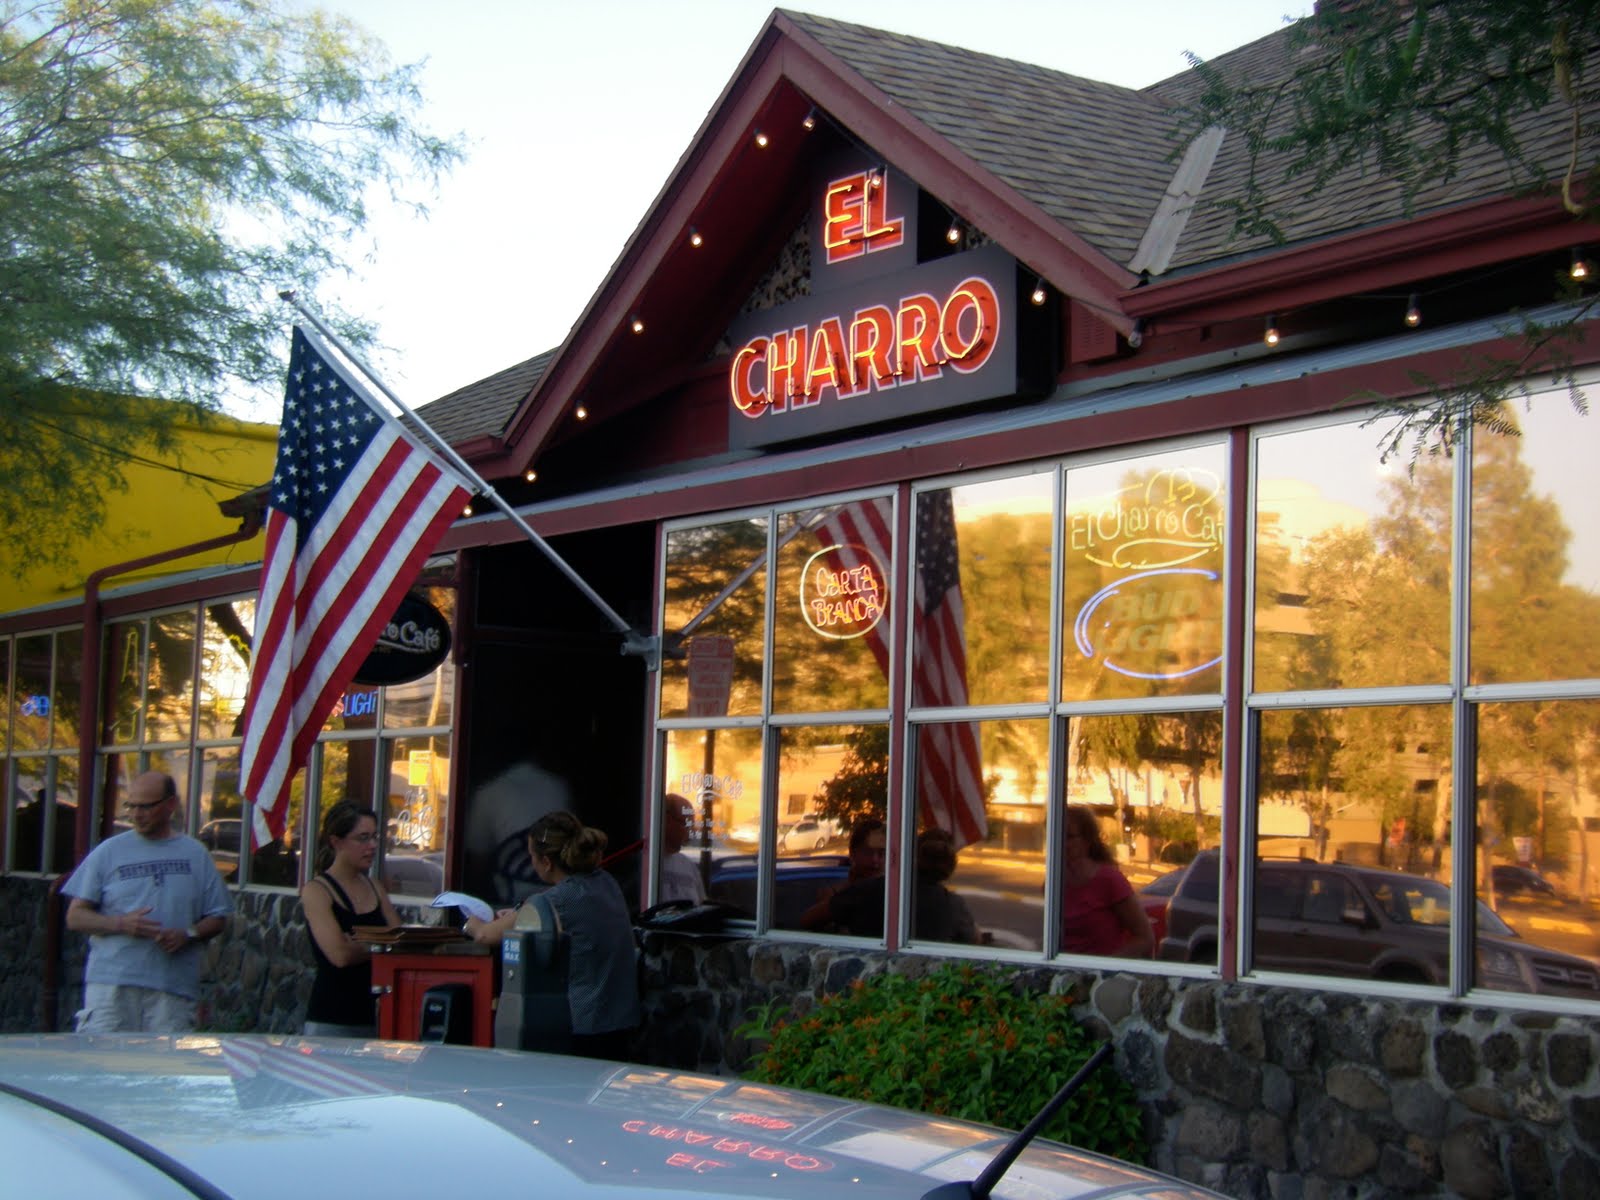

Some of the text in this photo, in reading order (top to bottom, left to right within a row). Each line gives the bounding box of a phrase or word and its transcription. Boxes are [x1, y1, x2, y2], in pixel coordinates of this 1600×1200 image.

[825, 167, 905, 264] EL
[731, 276, 1000, 419] CHARRO
[1071, 504, 1096, 550] El
[1182, 503, 1225, 545] Caf
[400, 620, 441, 651] Café
